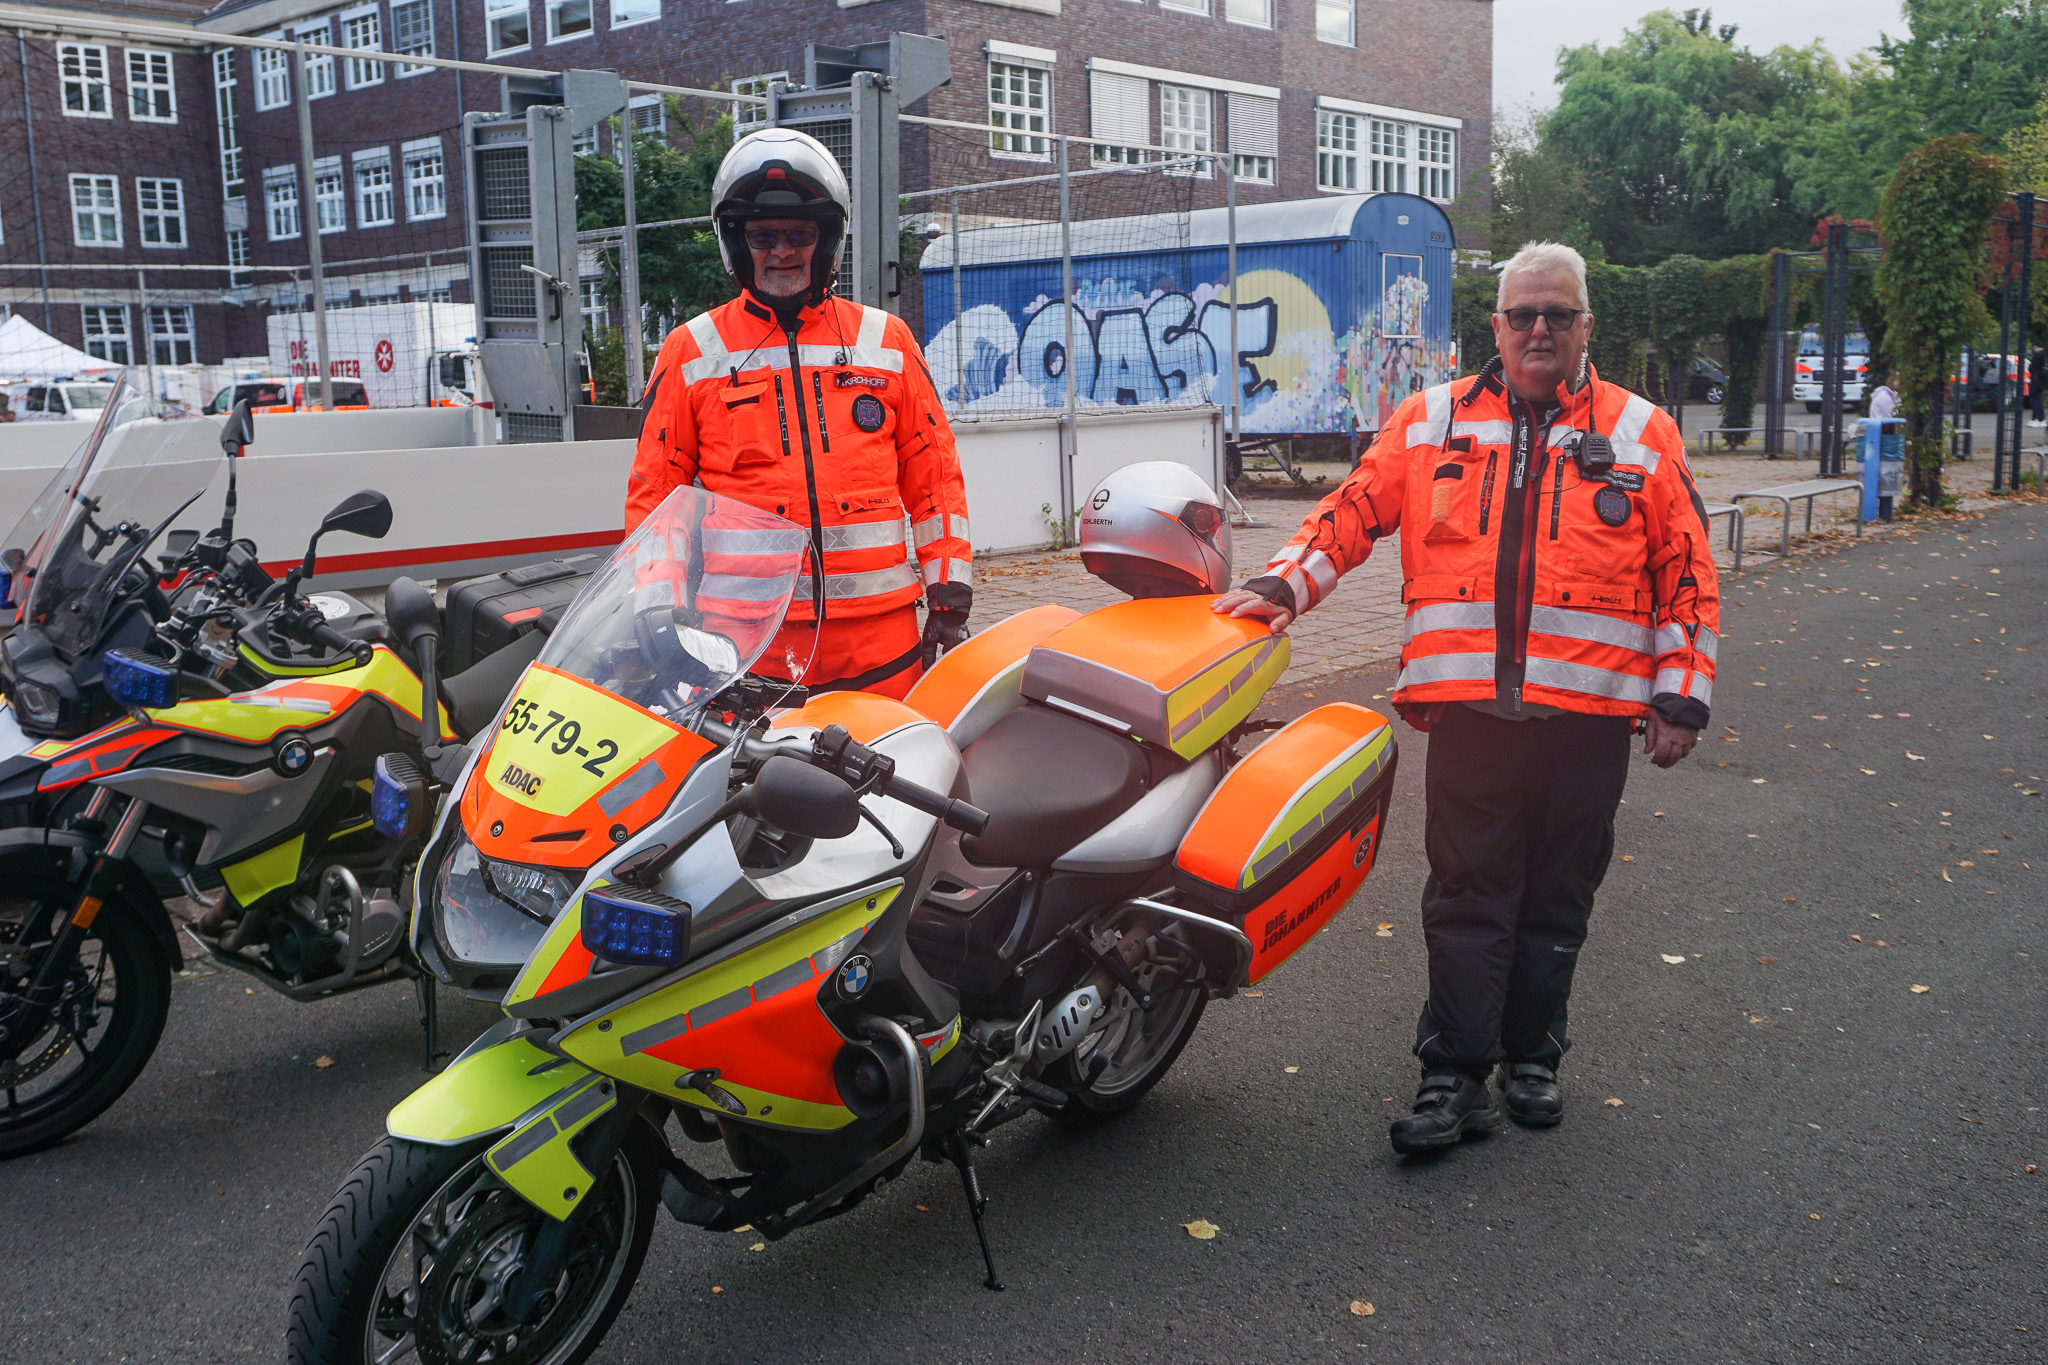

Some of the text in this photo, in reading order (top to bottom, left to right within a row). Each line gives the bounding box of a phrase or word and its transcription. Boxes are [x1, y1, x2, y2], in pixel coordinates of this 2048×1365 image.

[1018, 291, 1278, 405] OASE
[291, 360, 360, 378] JOHANITER
[501, 697, 619, 779] 55-79-2
[500, 764, 542, 796] ADAC
[1259, 876, 1342, 955] JOHANNITER
[1264, 908, 1288, 937] DIE
[840, 957, 873, 977] BMW
